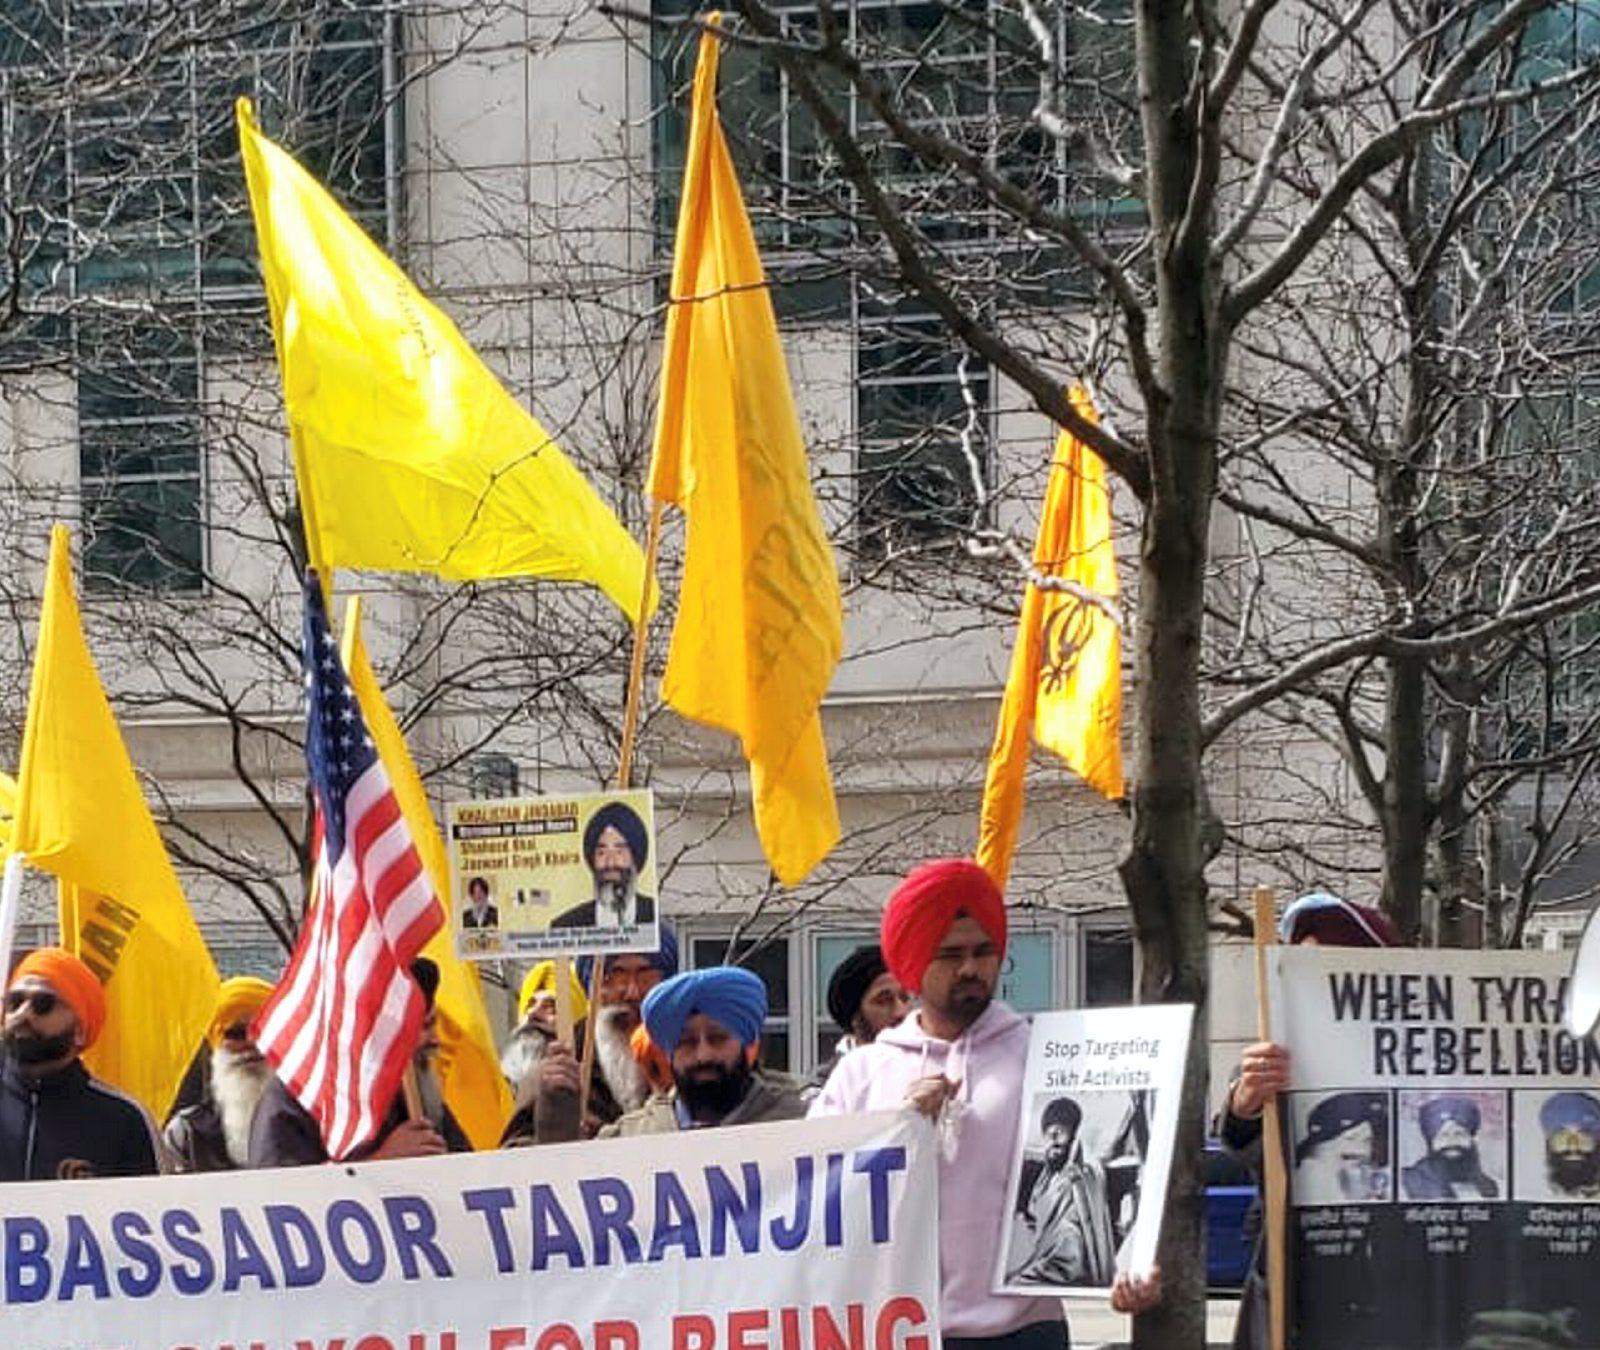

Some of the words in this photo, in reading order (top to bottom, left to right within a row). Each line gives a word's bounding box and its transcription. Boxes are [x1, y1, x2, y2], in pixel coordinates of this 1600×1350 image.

[1328, 973, 1453, 1022] WHEN
[1044, 1042, 1080, 1059] Stop
[1084, 1037, 1161, 1060] Targeting
[1045, 1069, 1079, 1087] Sikh
[1083, 1068, 1151, 1086] Activists
[462, 1146, 906, 1274] TARANJIT
